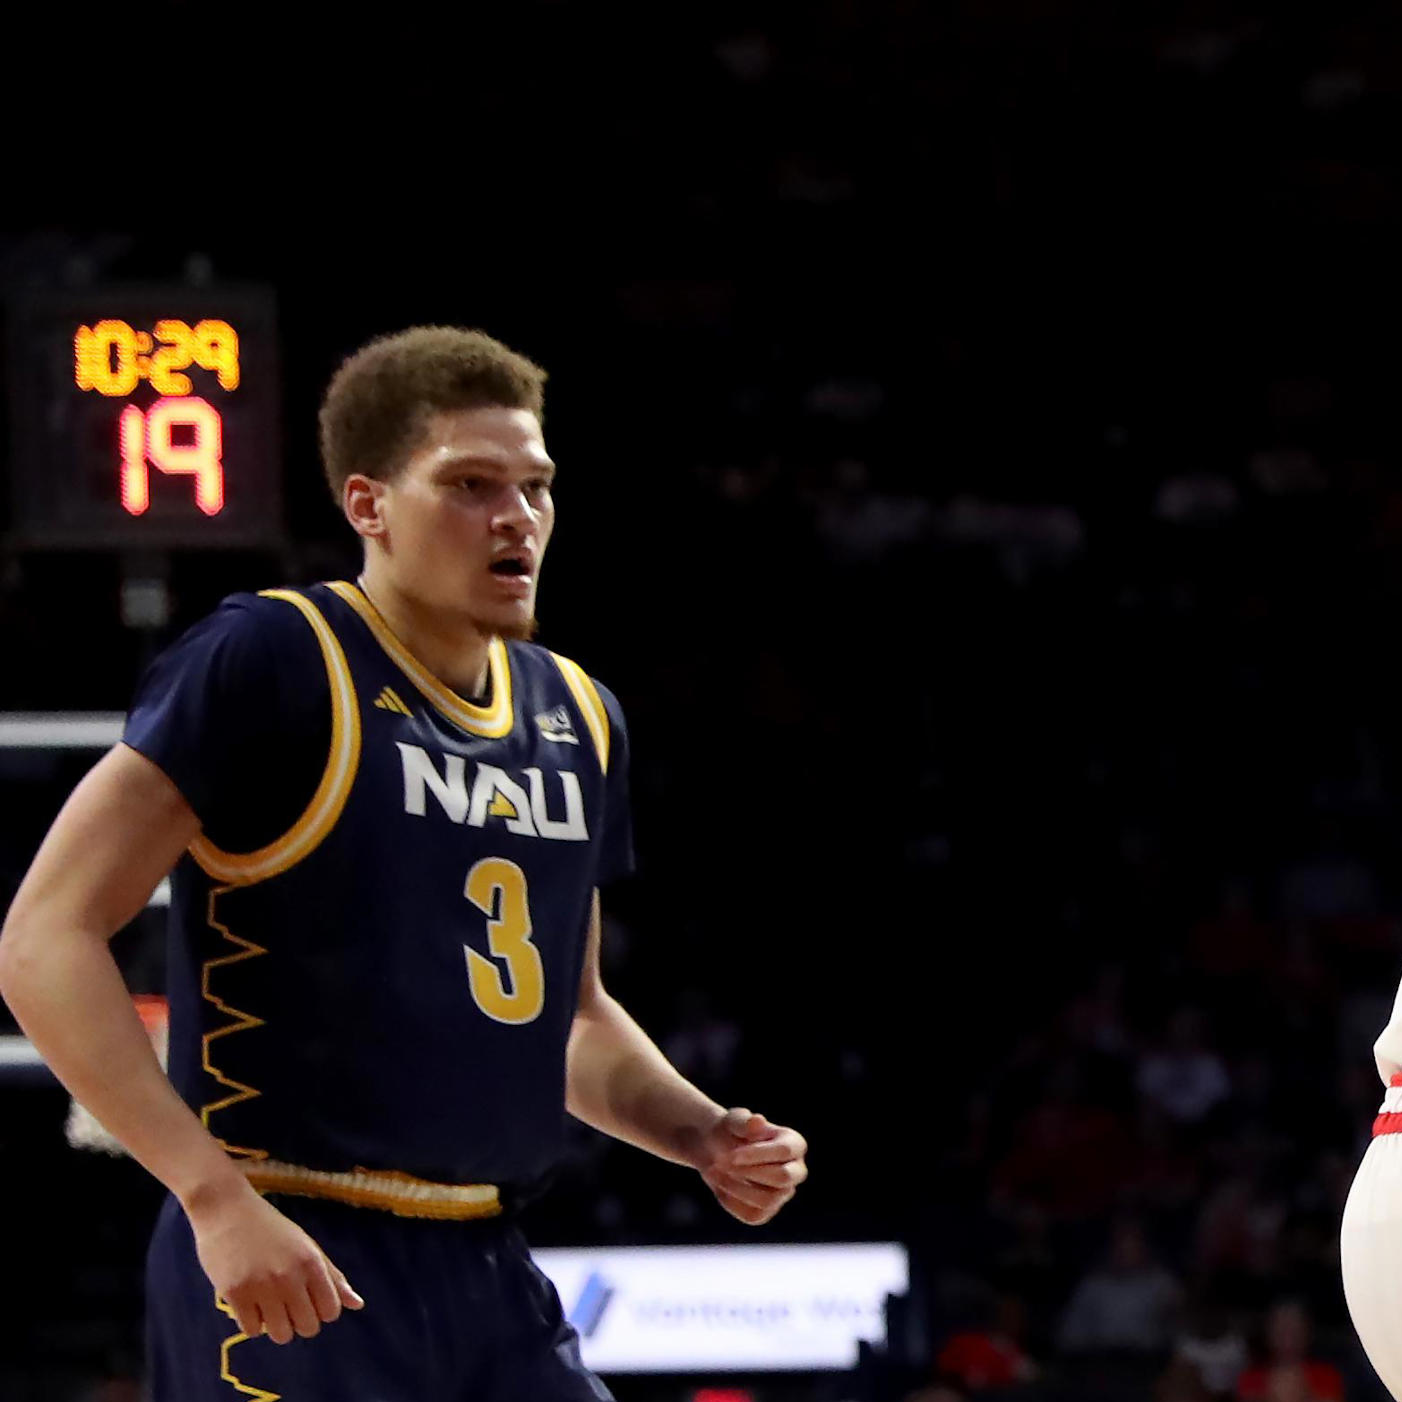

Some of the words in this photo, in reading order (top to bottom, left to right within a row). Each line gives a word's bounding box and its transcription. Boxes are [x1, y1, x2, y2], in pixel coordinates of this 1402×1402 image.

[75, 319, 240, 397] 10:29
[119, 395, 225, 516] 19
[396, 742, 590, 841] NAU
[463, 856, 545, 1025] 3
